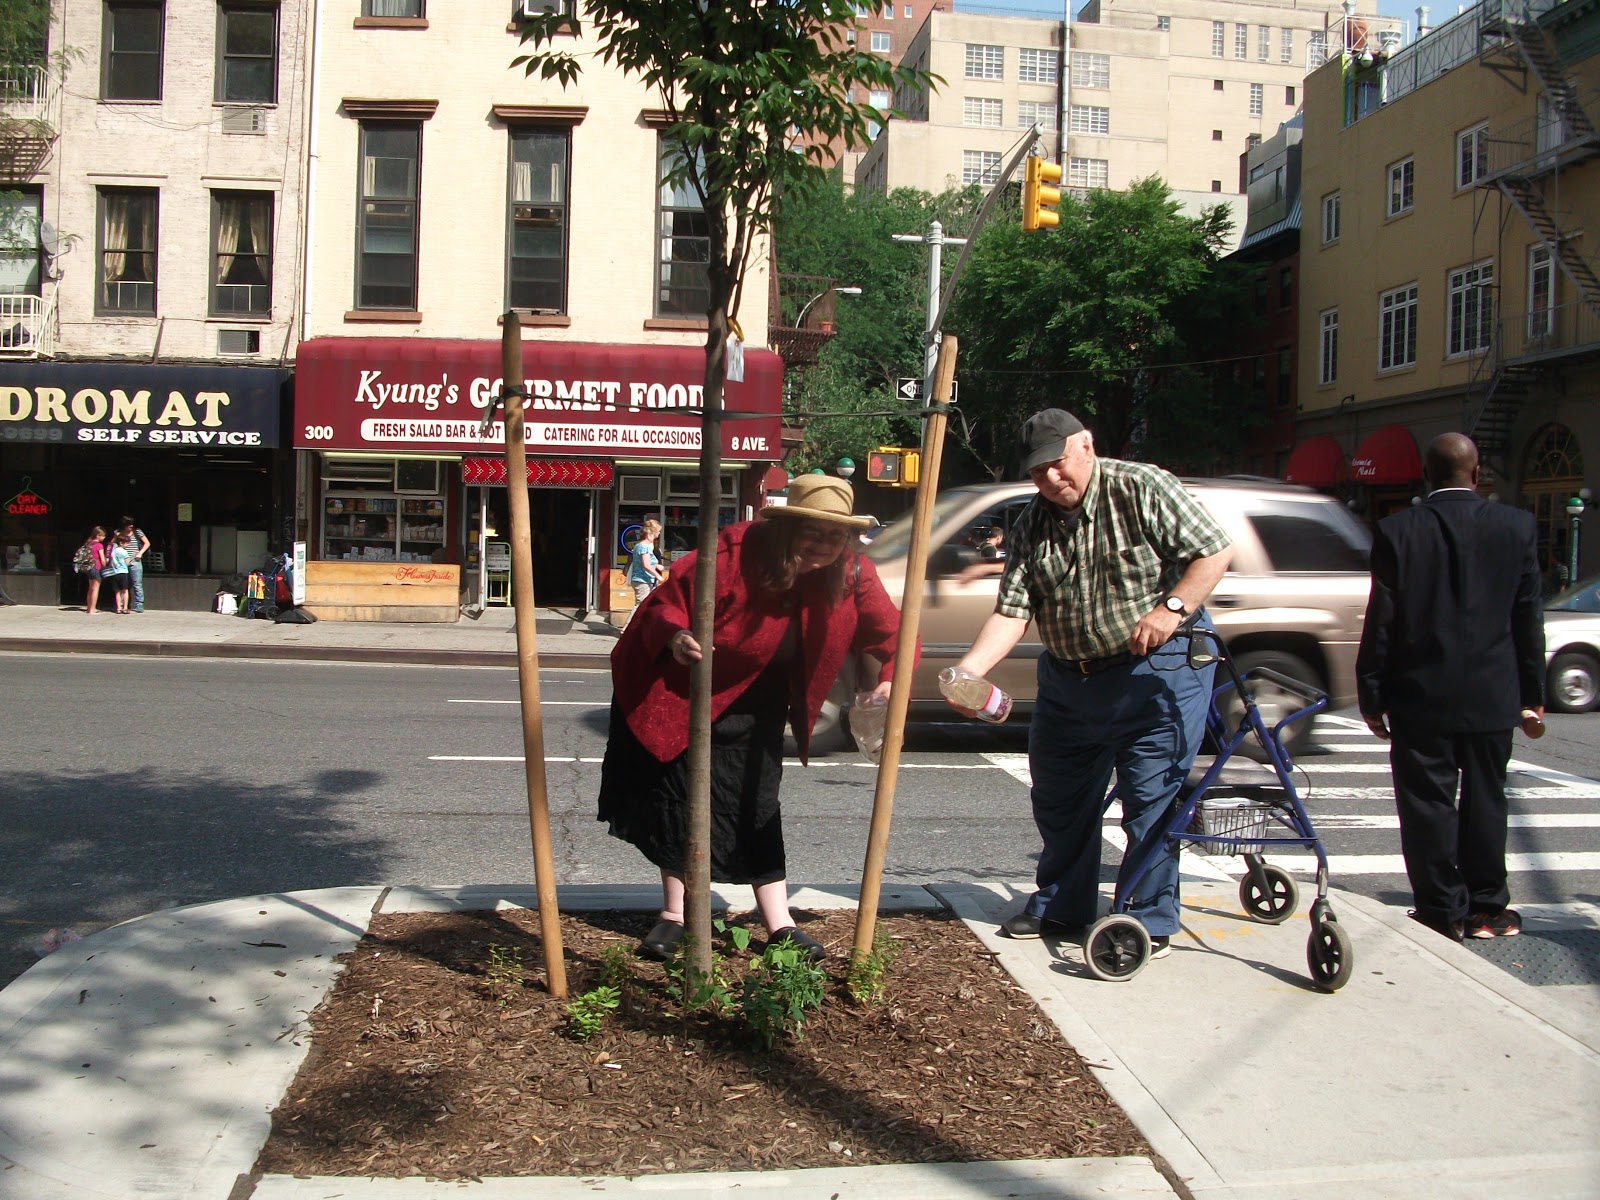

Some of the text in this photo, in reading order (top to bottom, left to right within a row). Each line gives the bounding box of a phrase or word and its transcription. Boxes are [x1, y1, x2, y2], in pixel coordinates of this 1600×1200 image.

[355, 370, 459, 411] Kyung's
[628, 382, 725, 414] FOOD
[907, 384, 923, 395] ONE
[77, 427, 261, 446] SELF SERVICE
[304, 425, 334, 440] 300
[373, 423, 406, 437] FRESH
[409, 423, 442, 438] SALAD
[446, 424, 466, 438] BAR
[469, 424, 477, 438] &
[544, 427, 595, 442] CATERING
[599, 429, 620, 443] FOR
[621, 429, 639, 444] ALL
[643, 430, 701, 446] OCCASIONS
[731, 436, 769, 451] 8 AVE.
[17, 494, 37, 504] DRY
[8, 504, 48, 515] CLEANER
